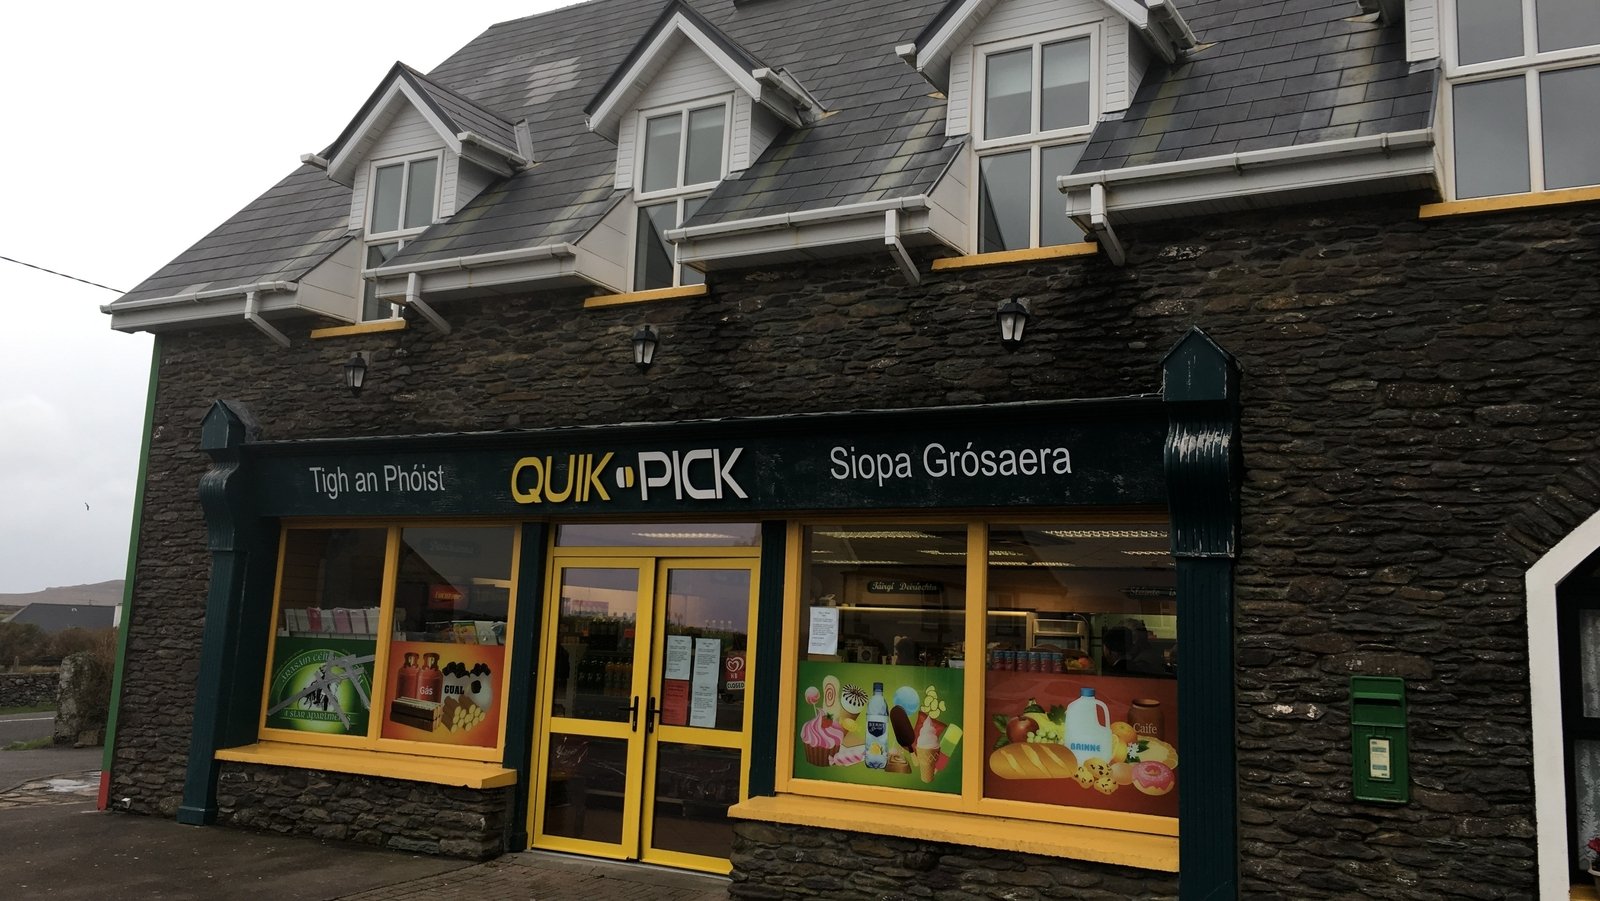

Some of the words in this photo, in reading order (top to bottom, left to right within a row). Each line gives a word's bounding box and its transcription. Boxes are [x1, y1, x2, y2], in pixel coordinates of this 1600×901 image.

[830, 446, 912, 487] Siopa
[923, 441, 1072, 477] Grósaera
[309, 466, 349, 499] Tigh
[355, 472, 378, 492] an
[384, 464, 445, 491] Phóist
[511, 452, 615, 504] QUIK
[638, 447, 749, 501] PICK
[420, 685, 434, 695] Gás
[444, 684, 465, 695] GUAL
[1133, 722, 1157, 734] Caife
[1070, 742, 1101, 752] BAINNE
